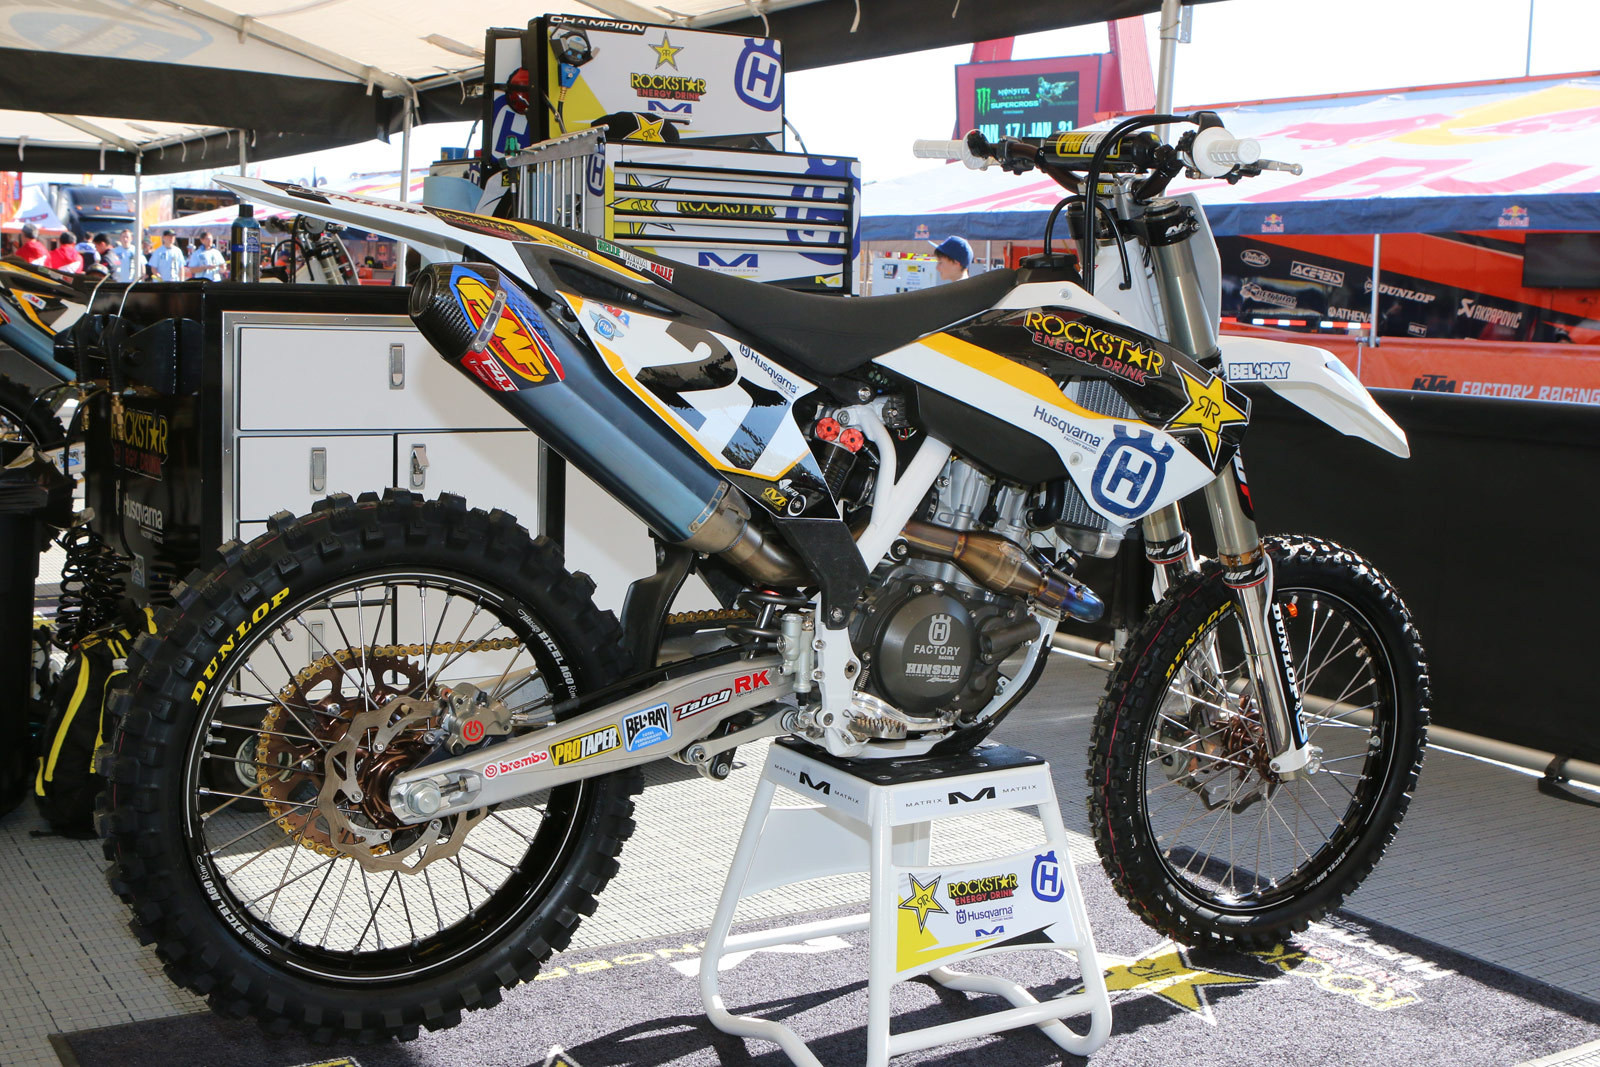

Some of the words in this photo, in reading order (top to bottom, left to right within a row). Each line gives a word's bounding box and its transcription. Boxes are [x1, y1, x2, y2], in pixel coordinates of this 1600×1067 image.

[550, 16, 646, 32] CHAMPION
[630, 73, 706, 93] ROCKSTAR
[637, 88, 671, 99] ENERGY
[674, 90, 700, 101] DRINK
[991, 100, 1039, 109] SUPERCROSS
[1379, 284, 1436, 303] DUNLOP
[1025, 311, 1164, 375] ROCKSTAR
[1034, 331, 1097, 364] ENERGY
[1102, 356, 1147, 384] DRINK
[750, 351, 798, 394] Husqvarna
[1411, 374, 1457, 393] KTM
[1461, 381, 1534, 400] FACTORY
[1033, 405, 1101, 448] Husqvarna
[190, 586, 290, 707] DUNLOP
[913, 644, 960, 656] FACTORY
[1166, 600, 1232, 681] DUNLOP
[1272, 602, 1300, 700] DUNLOP
[538, 630, 564, 665] EXCEL
[560, 665, 575, 685] A60
[905, 663, 962, 676] HINSON
[735, 669, 770, 694] RK
[675, 689, 732, 715] Talon
[499, 751, 548, 773] brembo
[774, 763, 797, 777] MATRIX
[834, 790, 860, 805] MATRIX
[905, 798, 942, 808] MATRIX
[1002, 784, 1037, 793] MATRIX
[203, 880, 221, 901] A60
[947, 873, 1018, 898] ROCKSTAR
[955, 892, 987, 906] ENERGY
[990, 888, 1014, 900] DRINK
[217, 900, 248, 936] EXCEL
[968, 906, 1013, 921] Husqvarna
